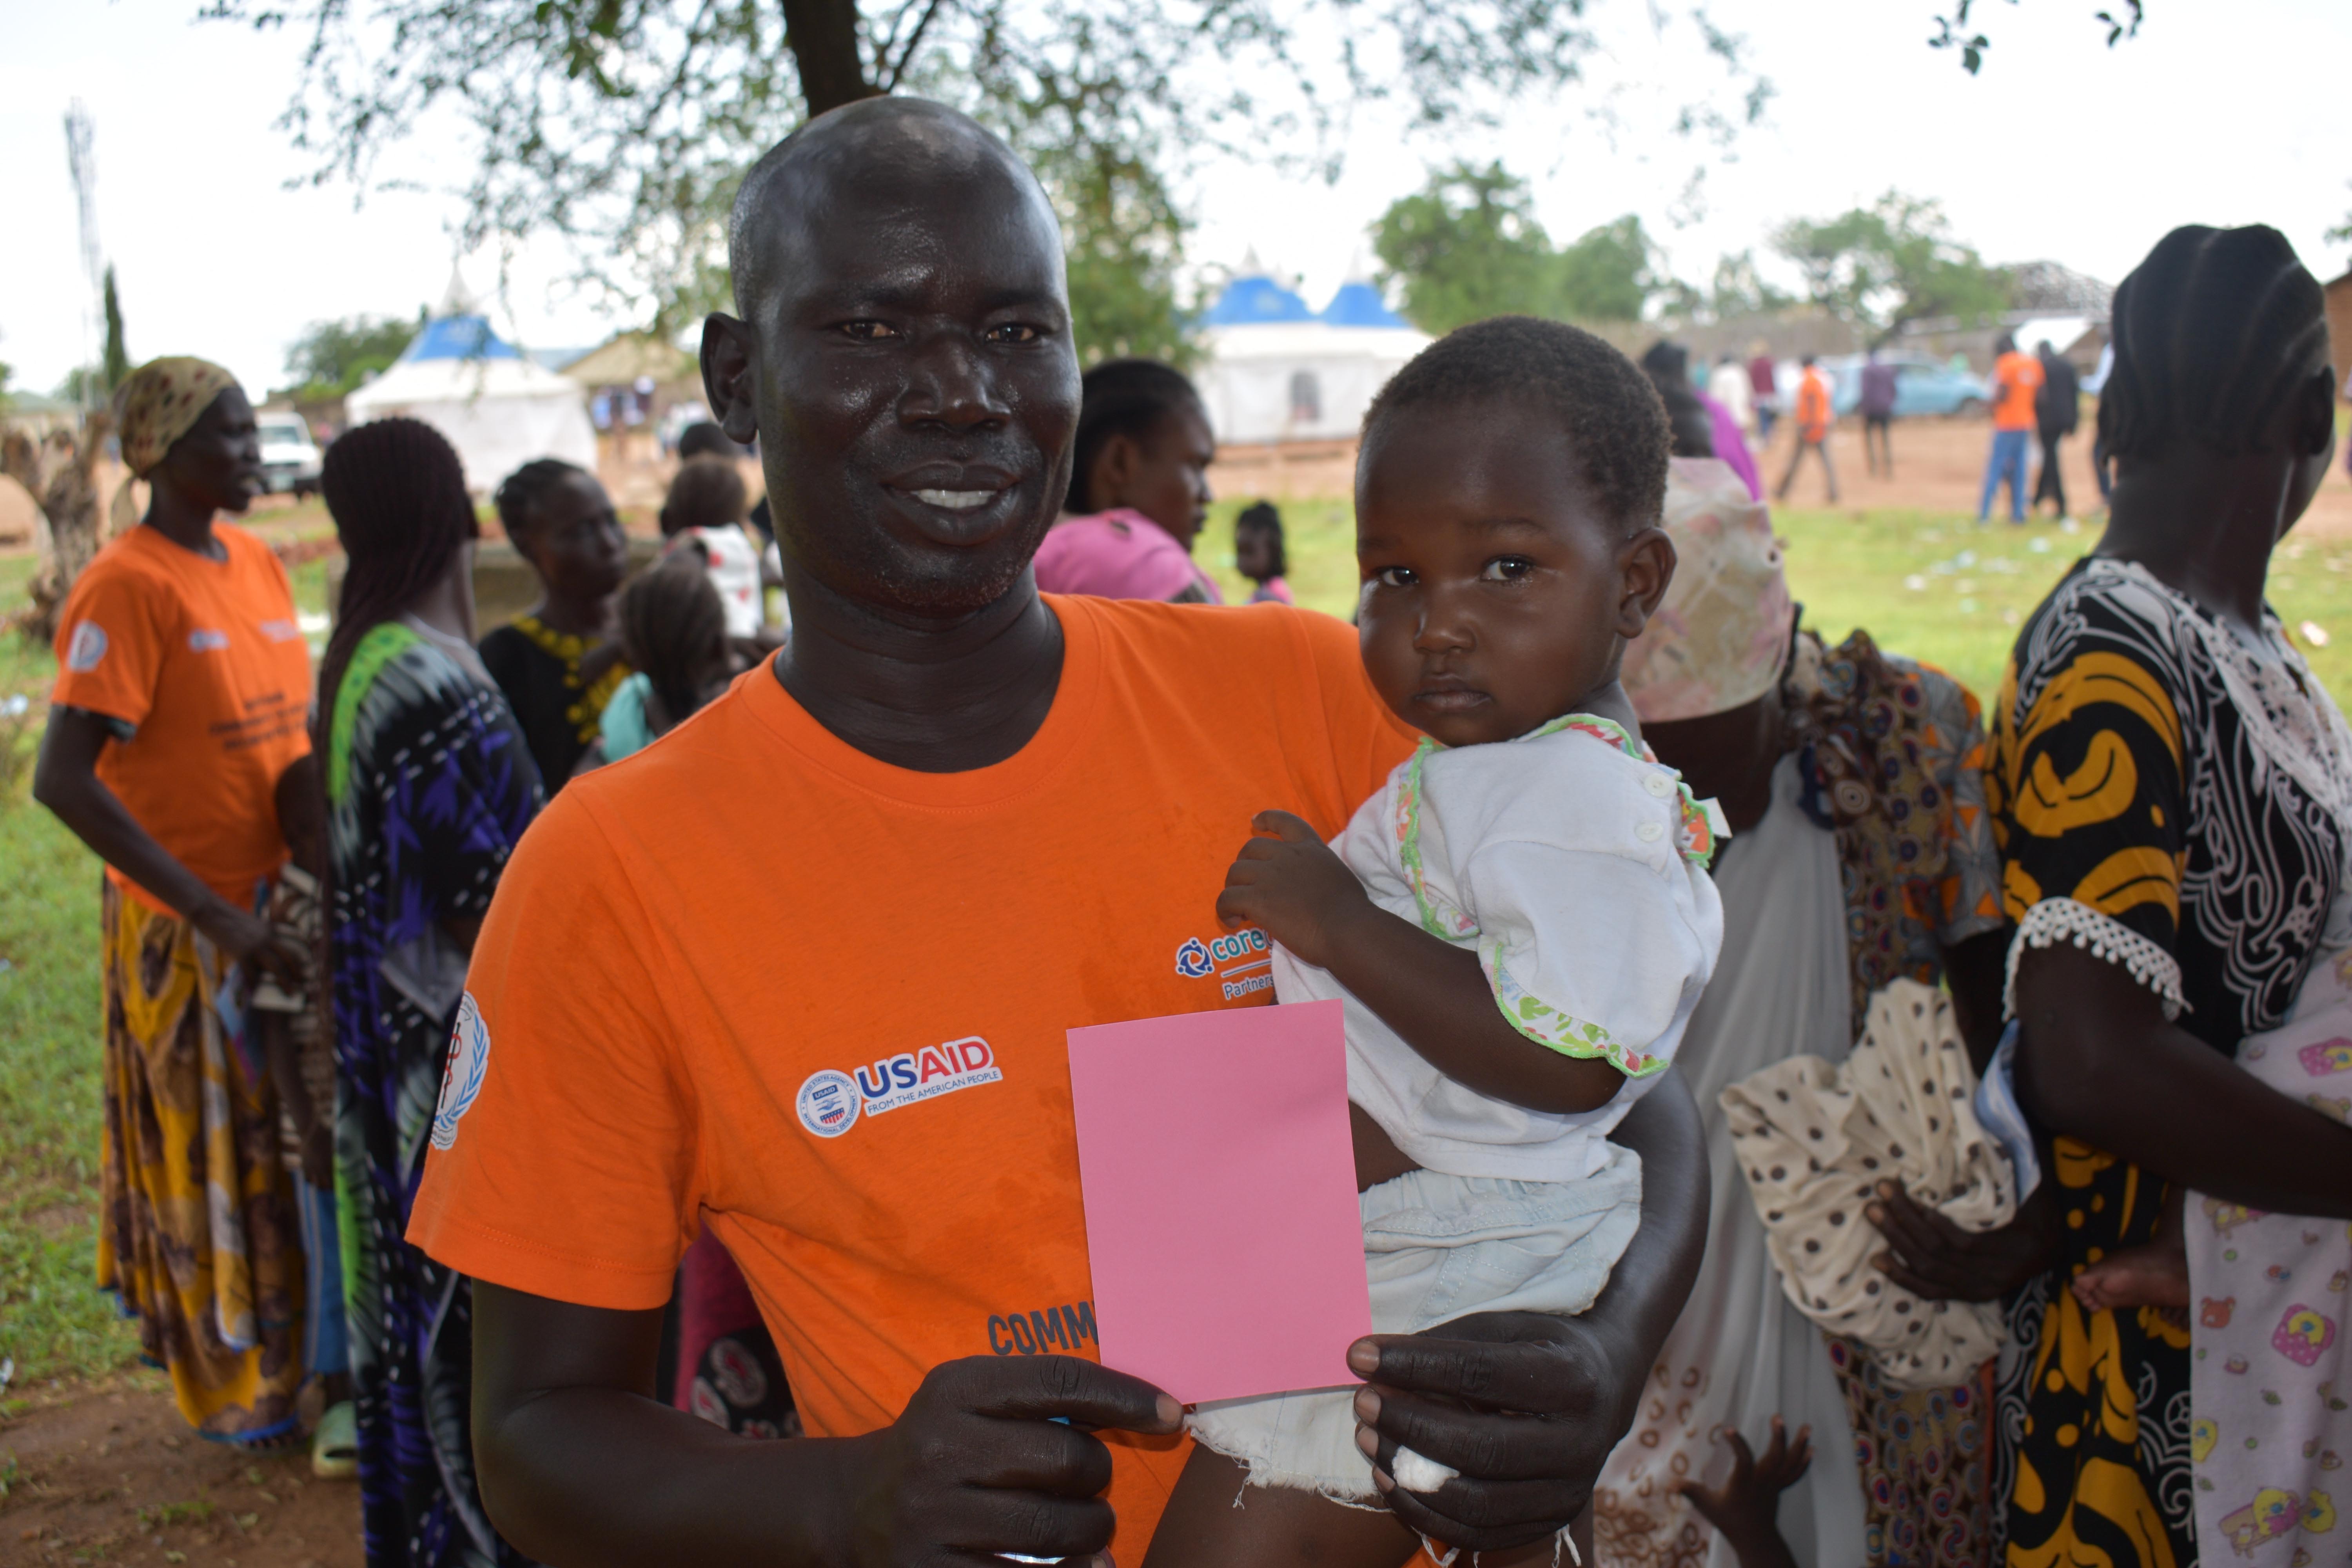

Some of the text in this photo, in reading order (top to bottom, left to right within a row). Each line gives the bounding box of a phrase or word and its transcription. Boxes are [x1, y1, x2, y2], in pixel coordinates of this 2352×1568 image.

[858, 1040, 990, 1098] USAID
[802, 1076, 849, 1103] UNITED STATES AGENCY
[815, 1086, 836, 1098] USAID
[868, 1071, 998, 1114] FROM THE AMERICAN PEOPLE
[803, 1096, 857, 1132] INTERNATIONAL DEVELOPMENT
[987, 1300, 1099, 1356] COMM
